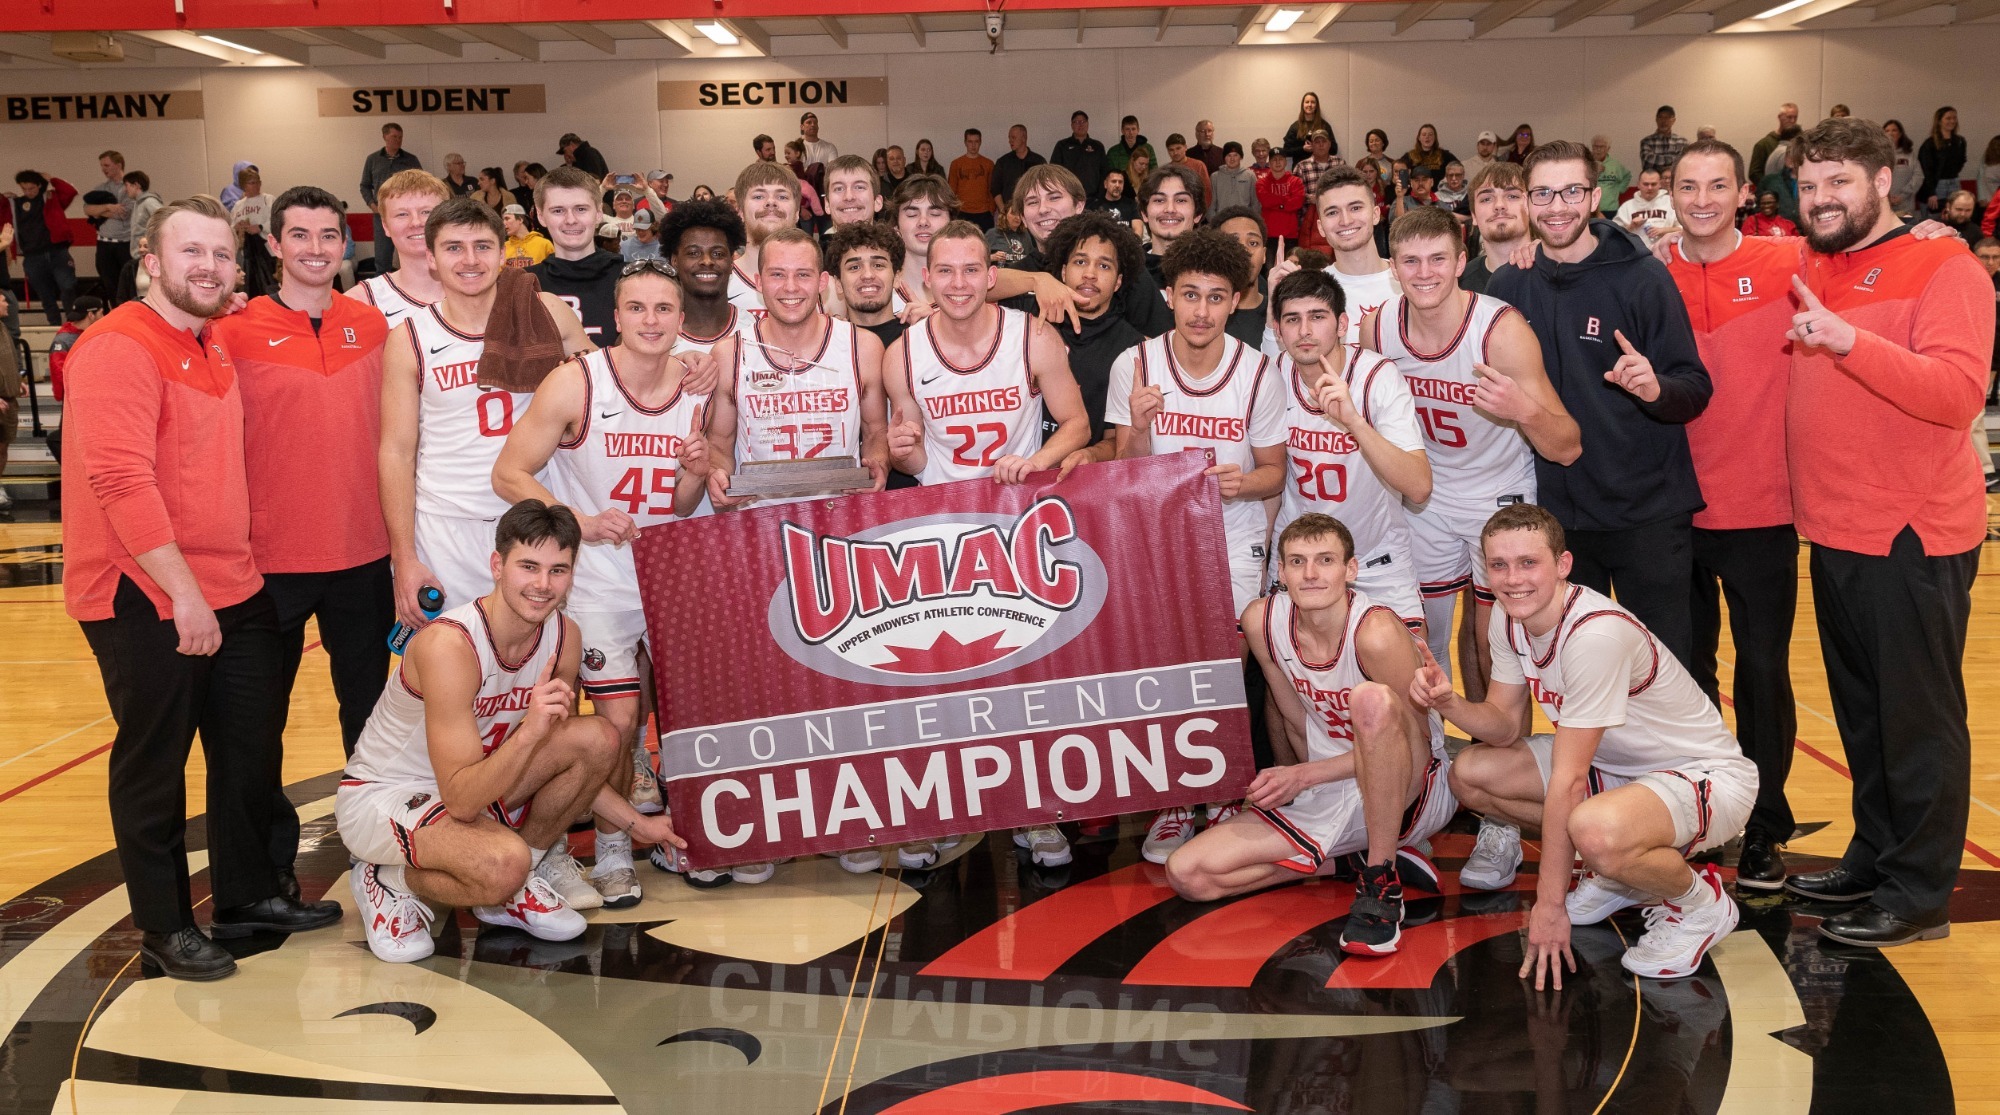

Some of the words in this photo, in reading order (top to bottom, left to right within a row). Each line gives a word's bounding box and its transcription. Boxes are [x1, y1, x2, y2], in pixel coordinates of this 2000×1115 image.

[7, 94, 170, 120] BETHANY
[352, 87, 510, 114] STUDENT
[699, 80, 848, 106] SECTION
[1737, 277, 1753, 296] B
[1863, 268, 1882, 286] B
[343, 327, 357, 344] B
[1587, 316, 1600, 336] B
[752, 370, 783, 382] UMAC
[477, 391, 514, 437] 0
[745, 388, 848, 418] VIKINGS
[925, 386, 1022, 419] VIKINGS
[1155, 411, 1244, 442] VIKINGS
[1415, 407, 1467, 448] 15
[946, 422, 1007, 467] 22
[610, 467, 675, 515] 45
[1292, 456, 1347, 502] 20
[781, 497, 1082, 643] UMAC
[837, 630, 871, 654] UPPER
[872, 612, 921, 636] MIDWEST
[924, 606, 974, 620] ATHLETIC
[977, 606, 1046, 629] CONFERENCE
[694, 668, 1217, 769] CONFERENCE
[700, 717, 1227, 849] CHAMPIONS
